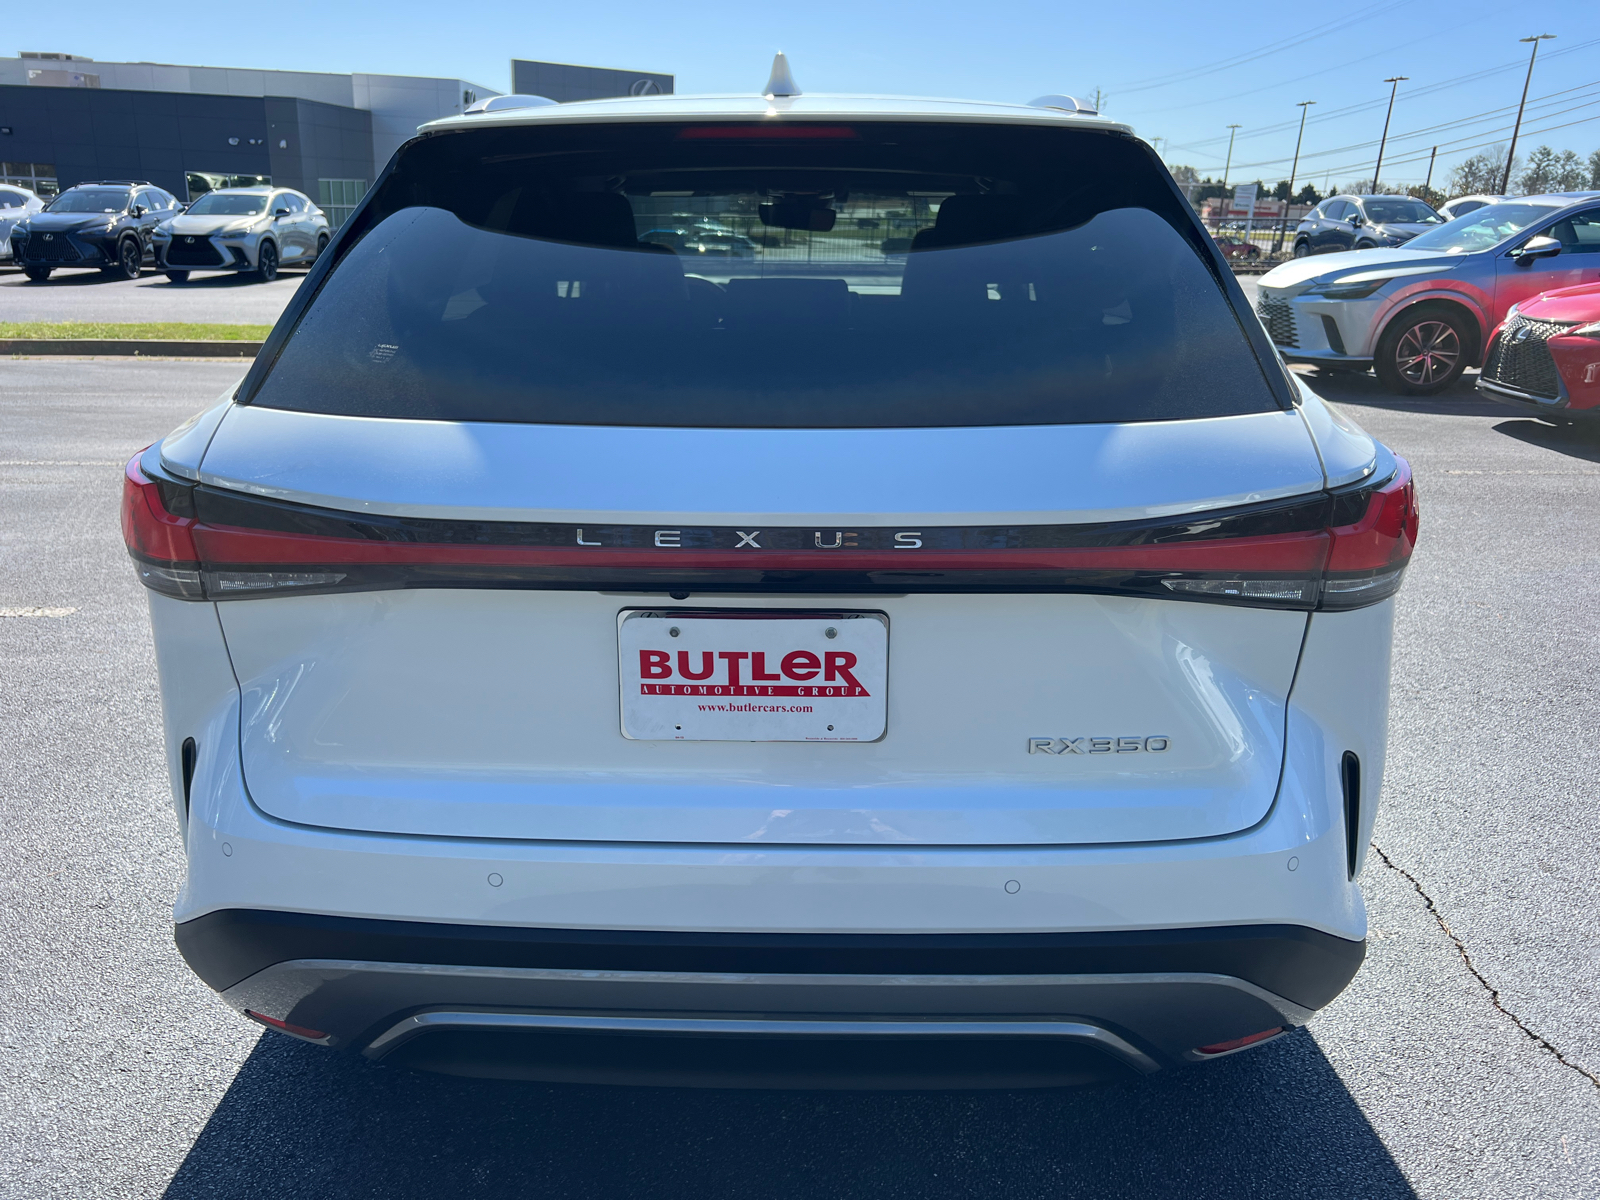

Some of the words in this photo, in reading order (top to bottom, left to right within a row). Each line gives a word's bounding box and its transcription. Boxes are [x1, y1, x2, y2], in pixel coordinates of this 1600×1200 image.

[576, 528, 923, 549] LEXUS
[642, 684, 775, 696] AUTOMOTIVE
[798, 686, 863, 696] GROUP
[697, 702, 814, 714] www.butlercars.com
[1028, 734, 1172, 755] RX350
